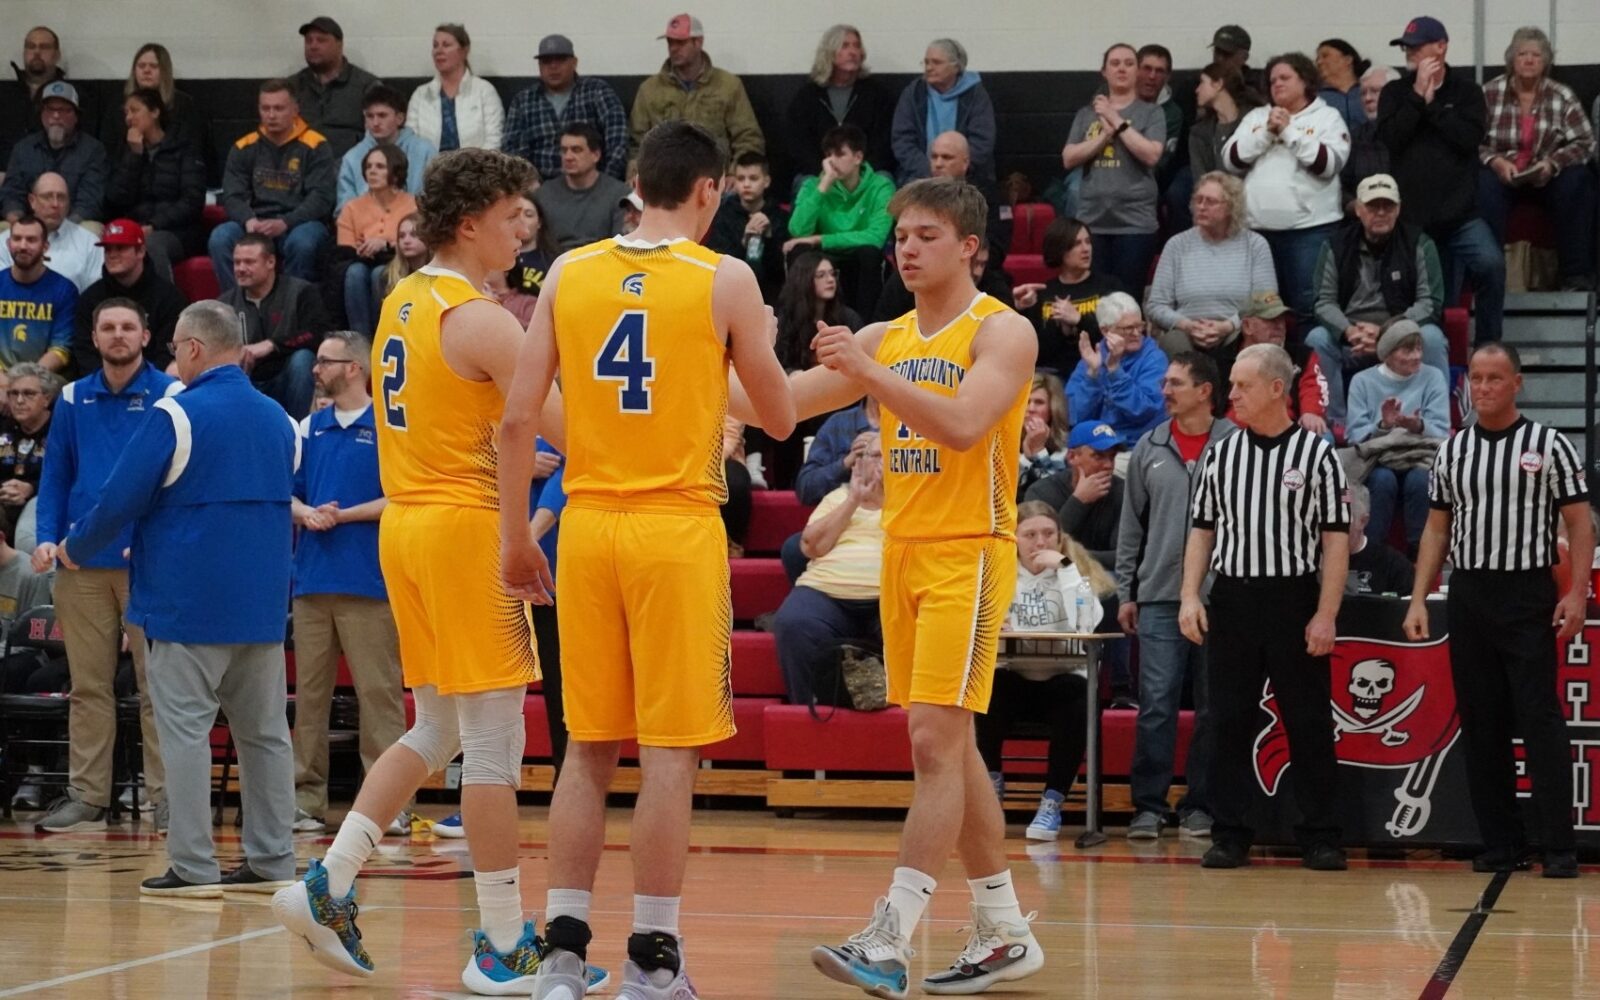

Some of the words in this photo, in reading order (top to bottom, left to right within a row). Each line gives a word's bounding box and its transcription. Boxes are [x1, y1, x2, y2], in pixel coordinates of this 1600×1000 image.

[380, 334, 408, 431] 2
[593, 309, 655, 413] 4
[889, 447, 942, 474] CENTRAL
[1017, 613, 1048, 627] FACE
